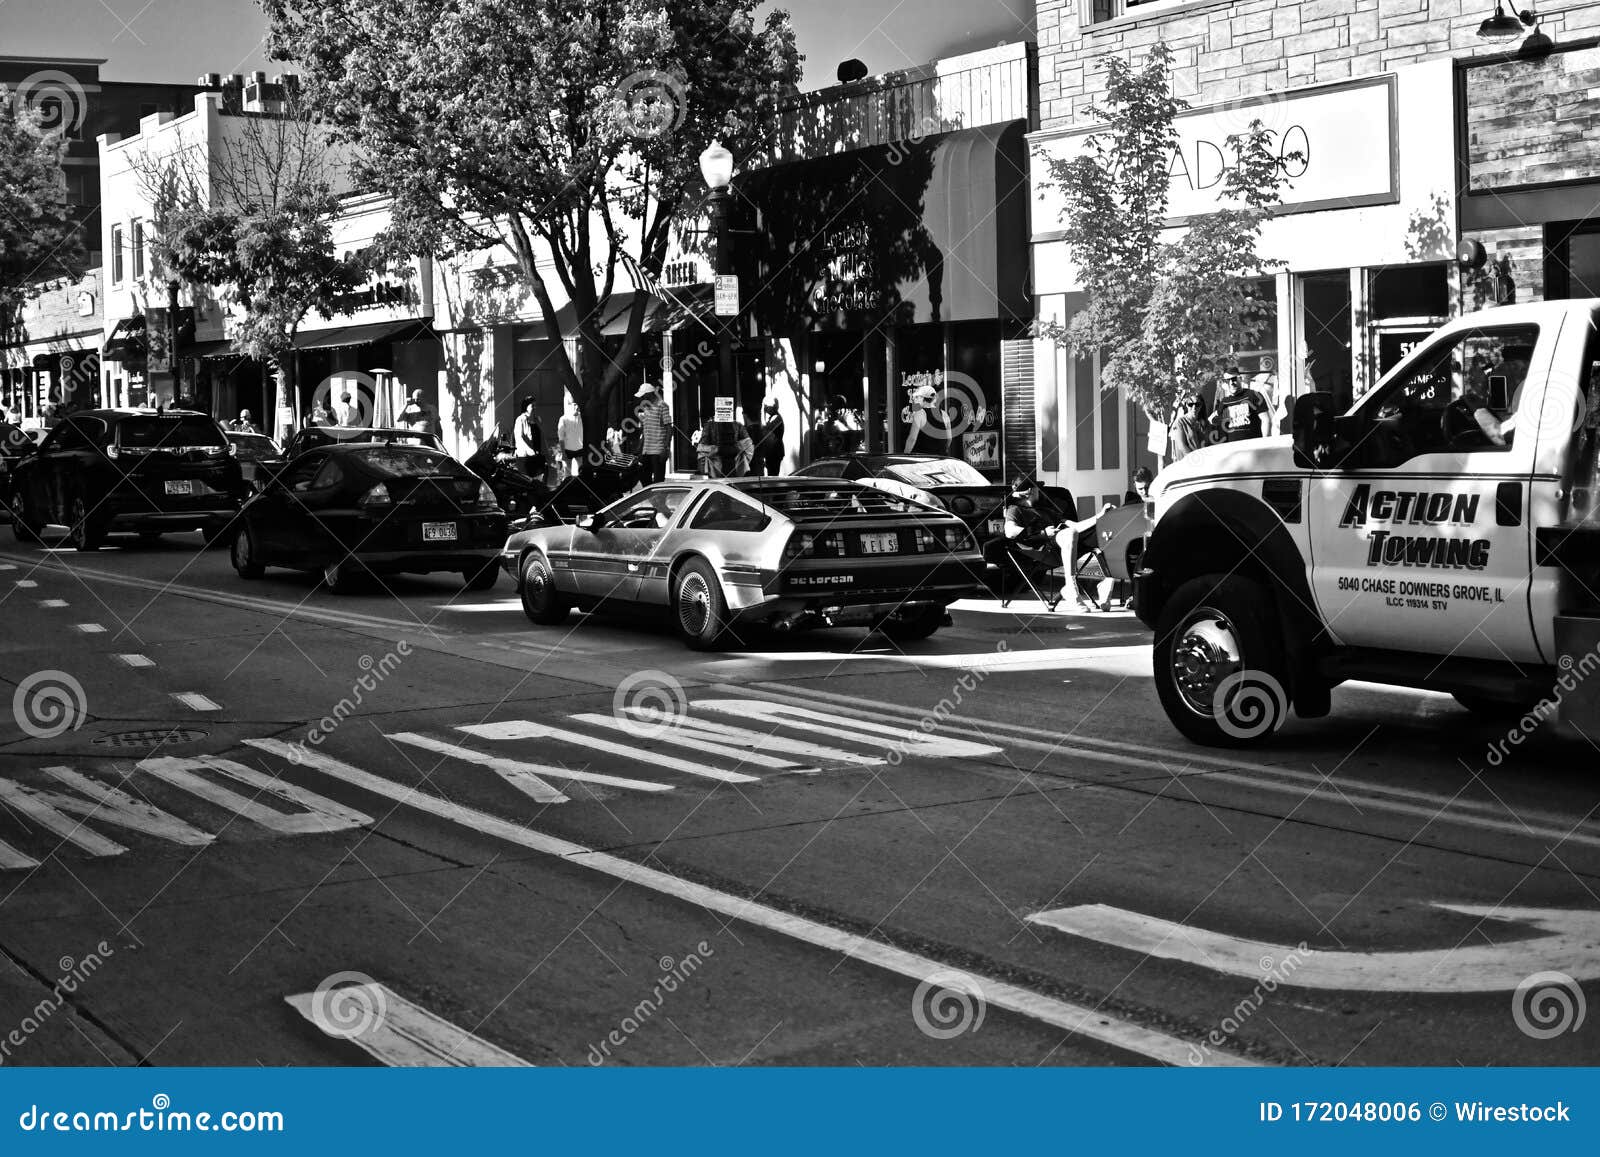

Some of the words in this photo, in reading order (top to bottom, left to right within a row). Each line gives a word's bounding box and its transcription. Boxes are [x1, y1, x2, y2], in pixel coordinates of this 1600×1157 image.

[1338, 483, 1481, 529] ACTION
[1366, 530, 1491, 571] TOWING
[1338, 577, 1359, 591] 5040
[1362, 578, 1396, 594] CHASE
[1400, 581, 1450, 598] DOWNERS
[1452, 584, 1493, 604] GROVE,
[1495, 587, 1504, 602] IL
[1386, 597, 1404, 607] ILCC
[1432, 600, 1448, 610] STV
